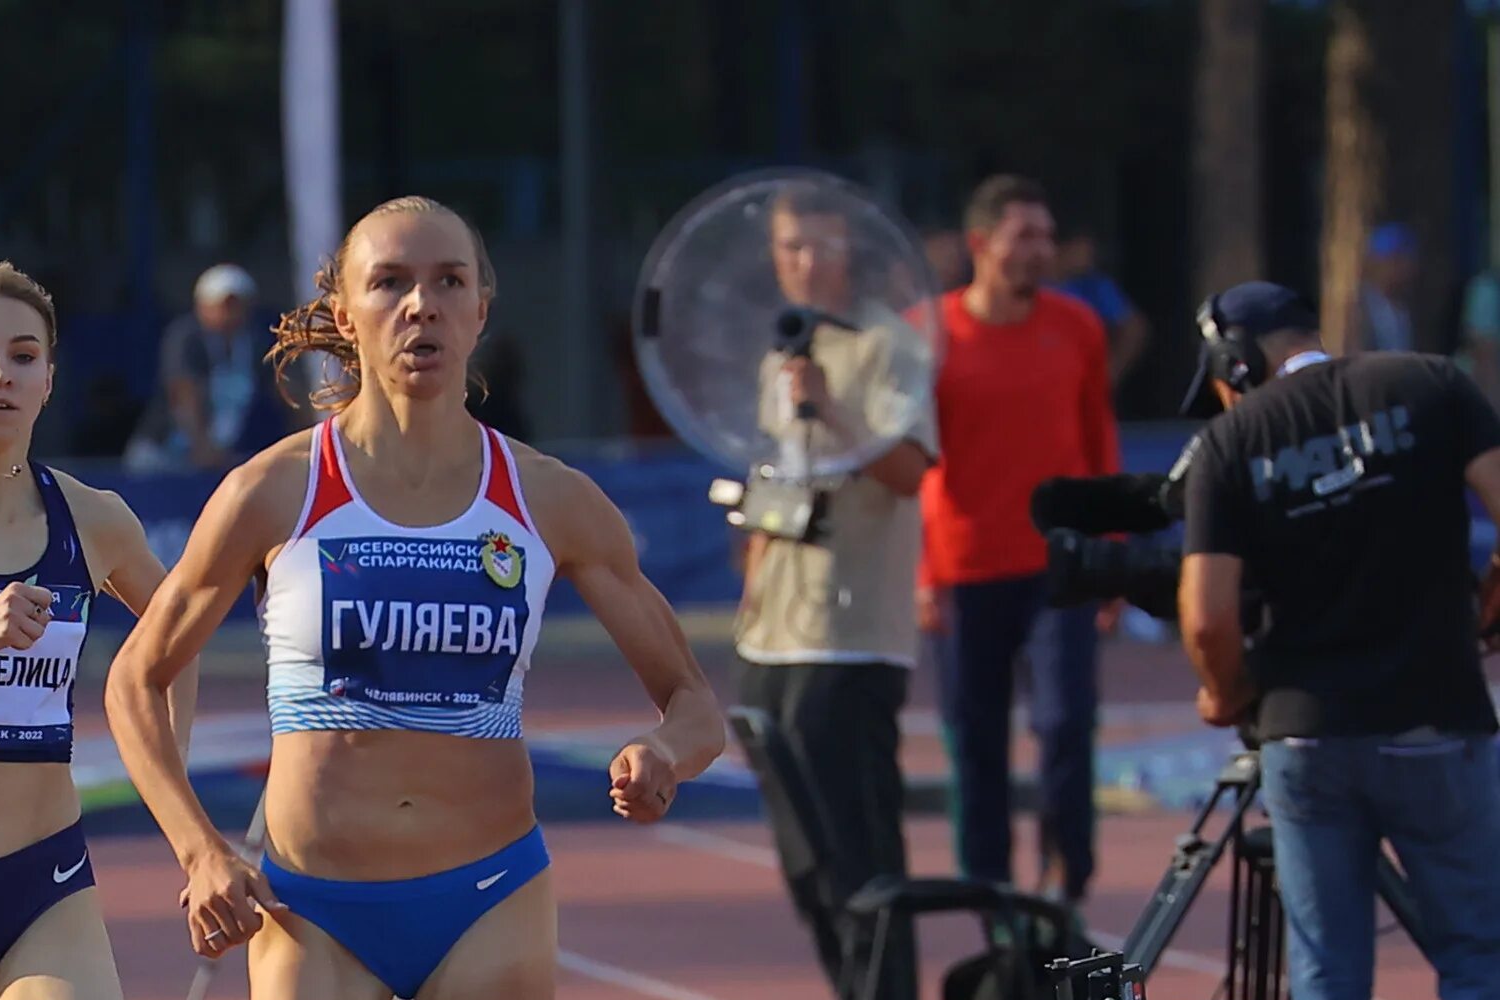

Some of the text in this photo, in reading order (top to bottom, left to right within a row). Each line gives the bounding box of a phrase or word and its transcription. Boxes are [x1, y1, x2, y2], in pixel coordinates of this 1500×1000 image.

[331, 599, 518, 655] ГУЛЯЕВА
[364, 687, 442, 703] ЧЕЛЯБИНСК
[18, 730, 43, 740] 2022
